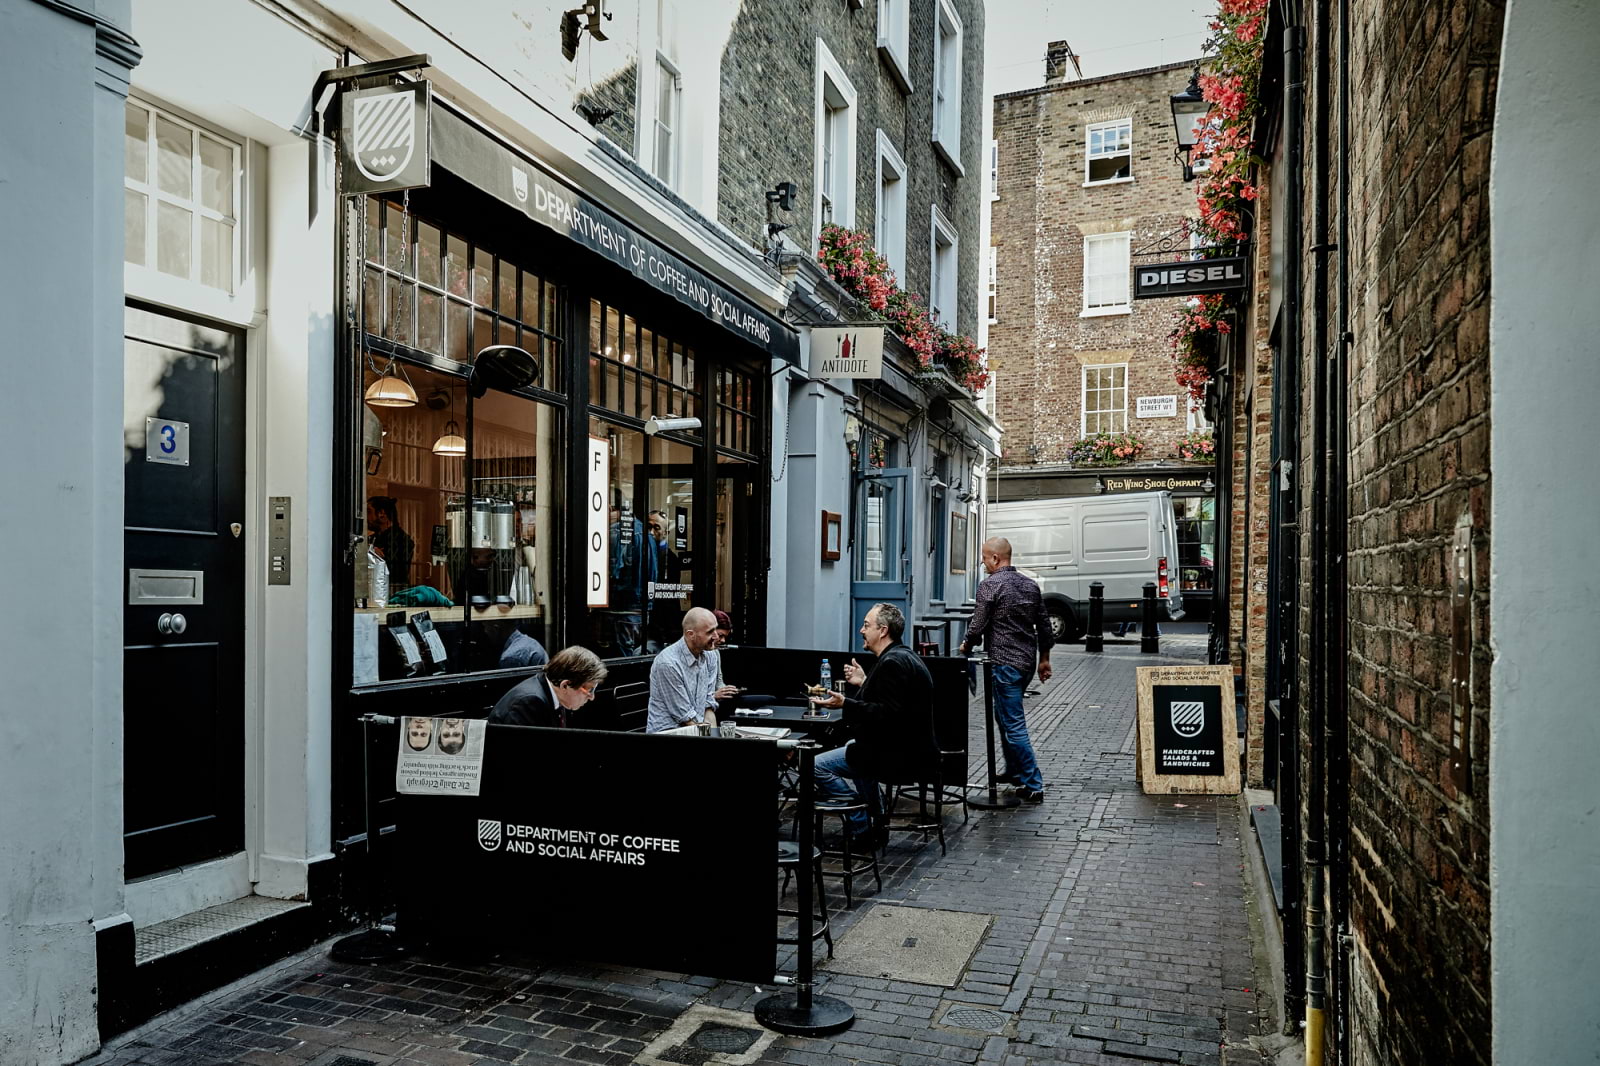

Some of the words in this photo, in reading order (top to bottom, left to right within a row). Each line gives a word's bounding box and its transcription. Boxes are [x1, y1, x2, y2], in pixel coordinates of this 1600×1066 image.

[534, 183, 627, 259] DEPARTMENT
[630, 244, 646, 270] OF
[648, 255, 688, 296] COFFEE
[688, 279, 709, 308] AND
[711, 293, 742, 328] SOCIAL
[742, 315, 770, 344] AFFAIRS
[1140, 265, 1242, 286] DIESEL
[821, 359, 869, 373] ANTIDOTE
[160, 425, 176, 454] 3
[1107, 479, 1123, 491] RED
[1123, 479, 1143, 491] WING
[1144, 478, 1167, 490] SHOE
[1167, 477, 1201, 490] COMPANY
[592, 451, 603, 592] FOOD
[406, 778, 439, 789] Telegraph
[440, 780, 457, 789] Daily
[458, 781, 470, 790] The
[506, 824, 596, 844] DEPARTMENT
[599, 833, 619, 847] OF
[622, 836, 680, 852] COFFEE
[506, 840, 535, 854] AND
[538, 843, 586, 859] SOCIAL
[589, 849, 646, 866] AFFAIRS
